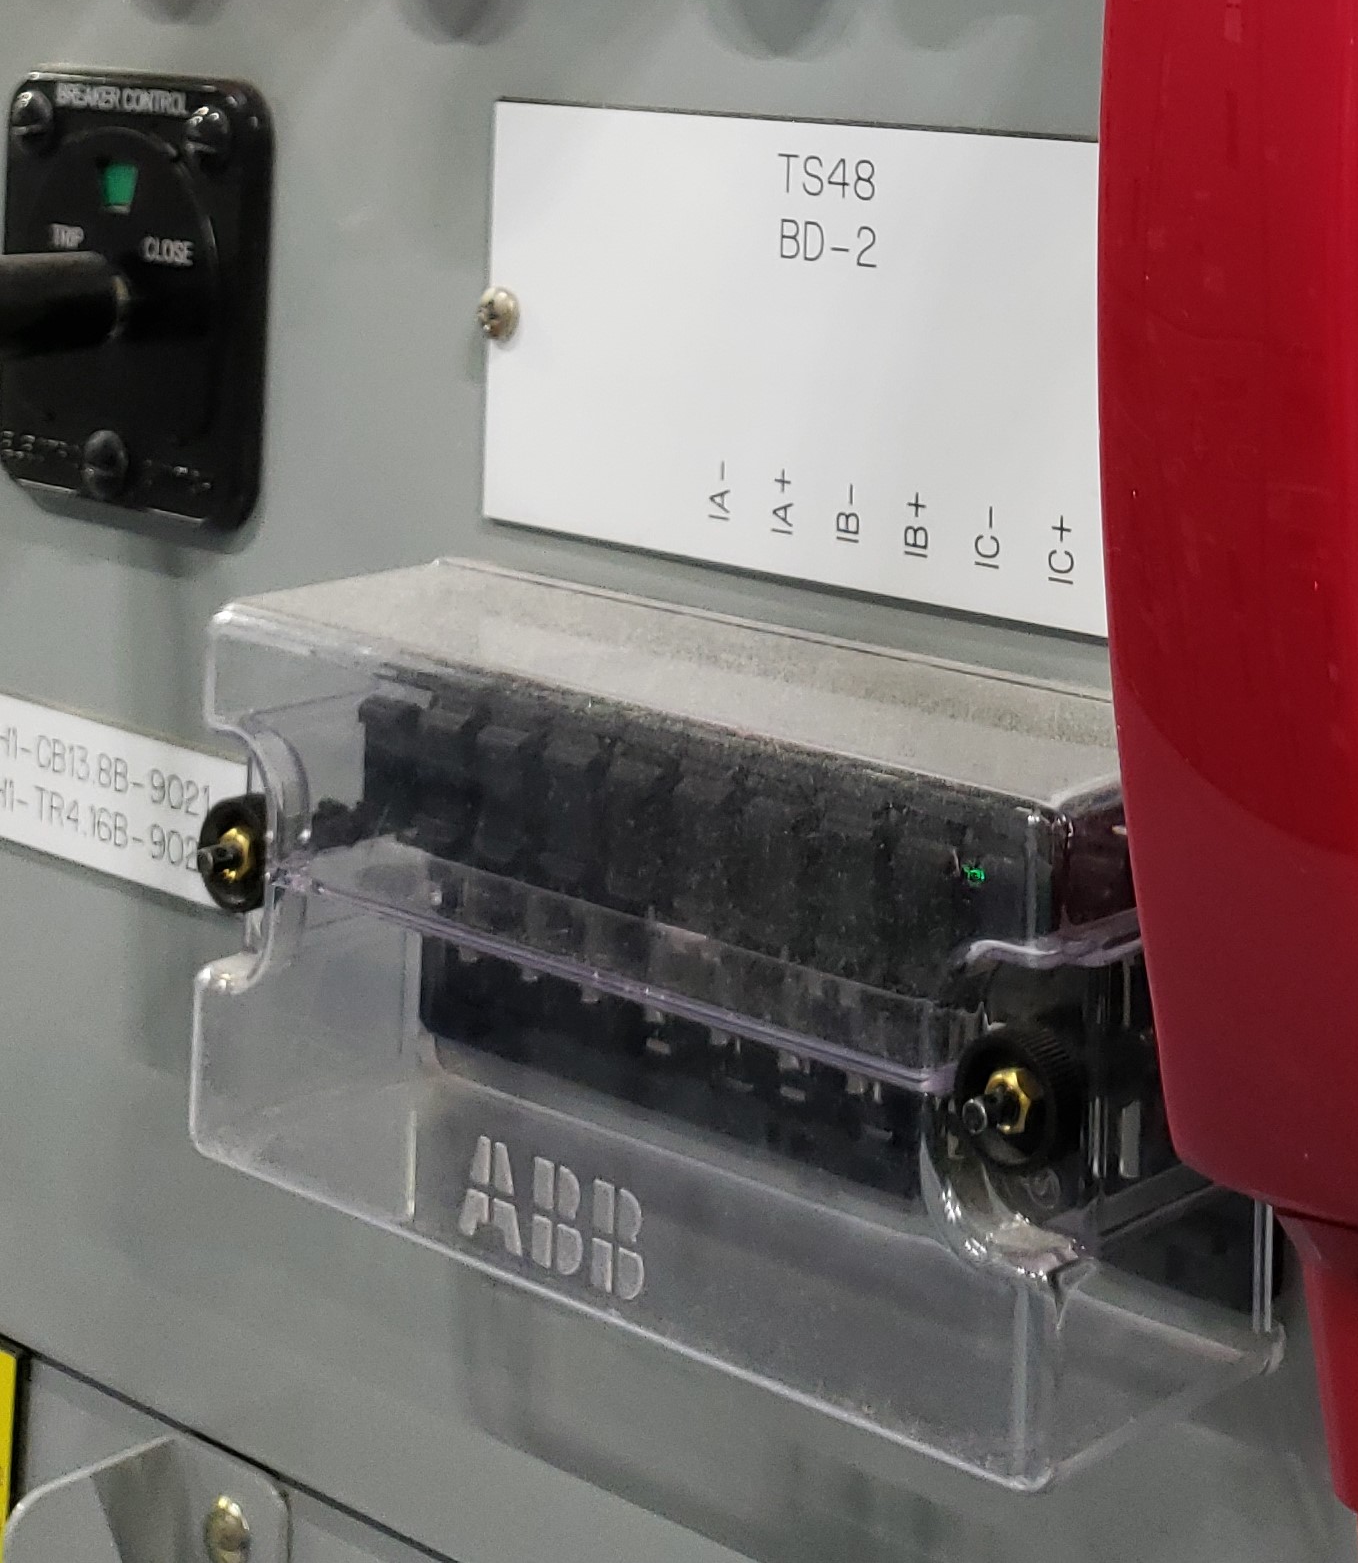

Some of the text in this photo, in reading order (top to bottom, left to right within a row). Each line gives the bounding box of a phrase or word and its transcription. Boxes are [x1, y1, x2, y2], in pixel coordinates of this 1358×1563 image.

[55, 82, 189, 116] BREAKER CONTROL
[778, 152, 876, 201] TS48
[141, 235, 194, 267] CLOSE
[779, 218, 878, 268] BD-2
[771, 468, 793, 535] IA+
[904, 492, 928, 559] IB+
[1048, 515, 1075, 585] IC+
[458, 1135, 645, 1301] ABB
